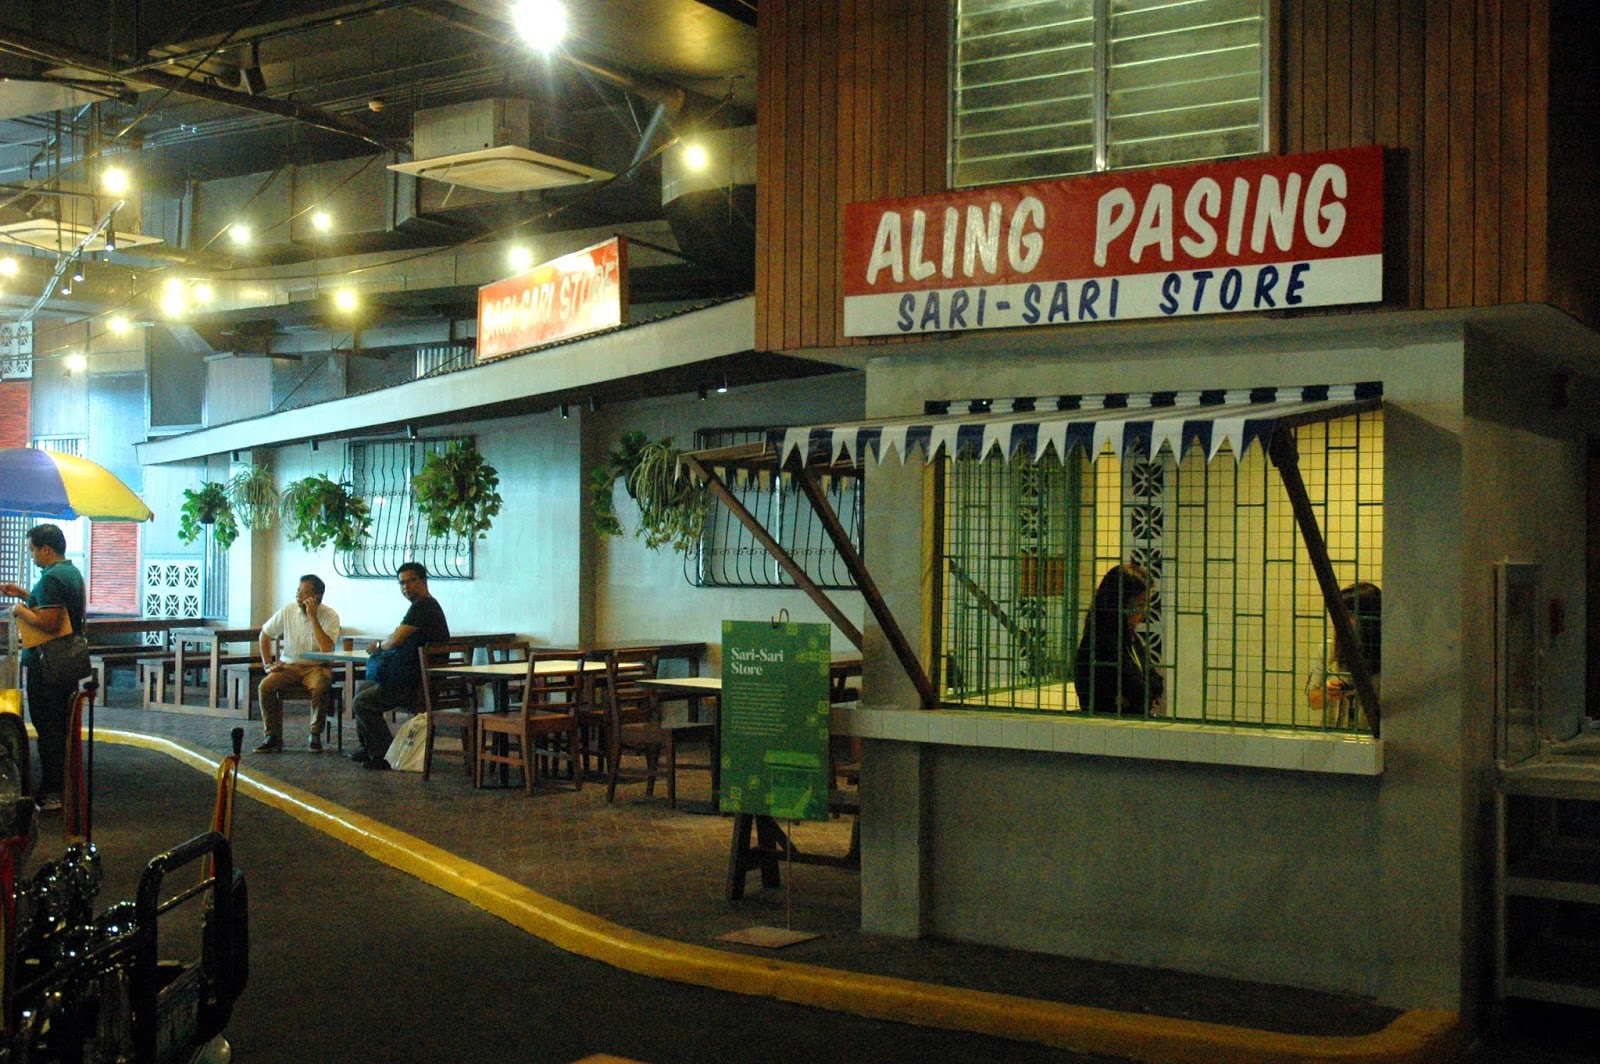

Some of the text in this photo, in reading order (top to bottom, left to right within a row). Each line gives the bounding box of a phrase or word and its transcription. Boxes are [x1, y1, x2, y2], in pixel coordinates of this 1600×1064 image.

[867, 163, 1348, 285] ALING PASING
[897, 263, 1311, 332] SARI-SARI STORE
[731, 647, 784, 662] Sari-Sari
[731, 661, 763, 675] Store
